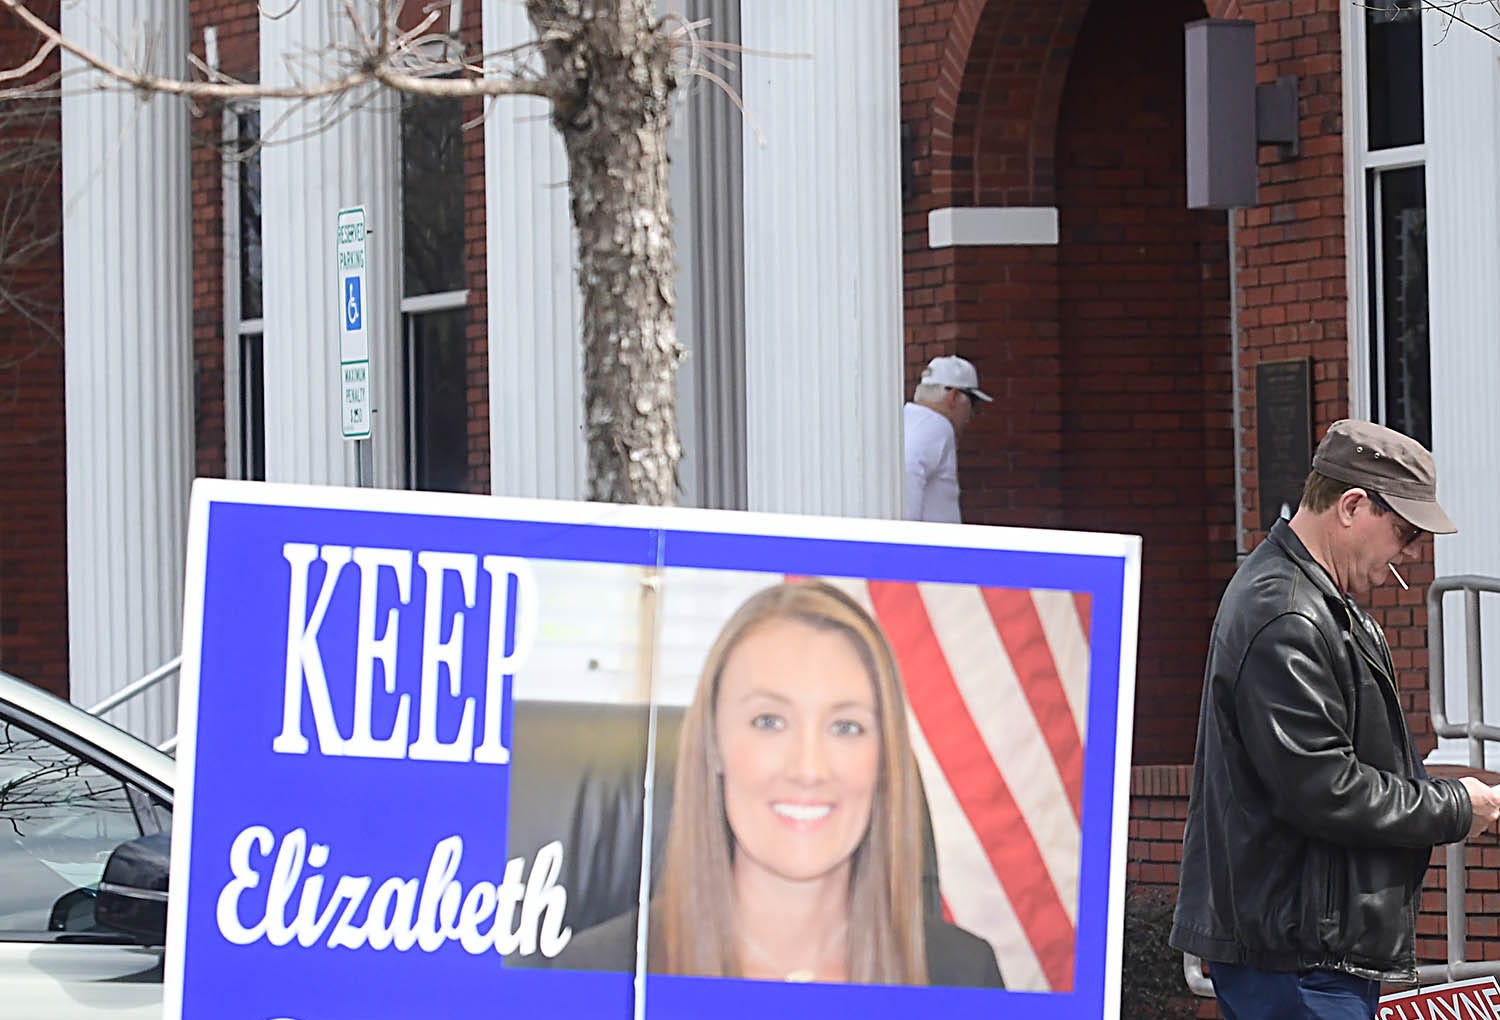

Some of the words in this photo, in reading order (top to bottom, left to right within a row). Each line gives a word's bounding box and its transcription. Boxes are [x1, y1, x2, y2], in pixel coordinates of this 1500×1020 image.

[338, 223, 364, 243] RESERVED
[340, 250, 364, 270] PARKING
[273, 542, 537, 764] KEEP
[217, 826, 572, 958] Elizabeth
